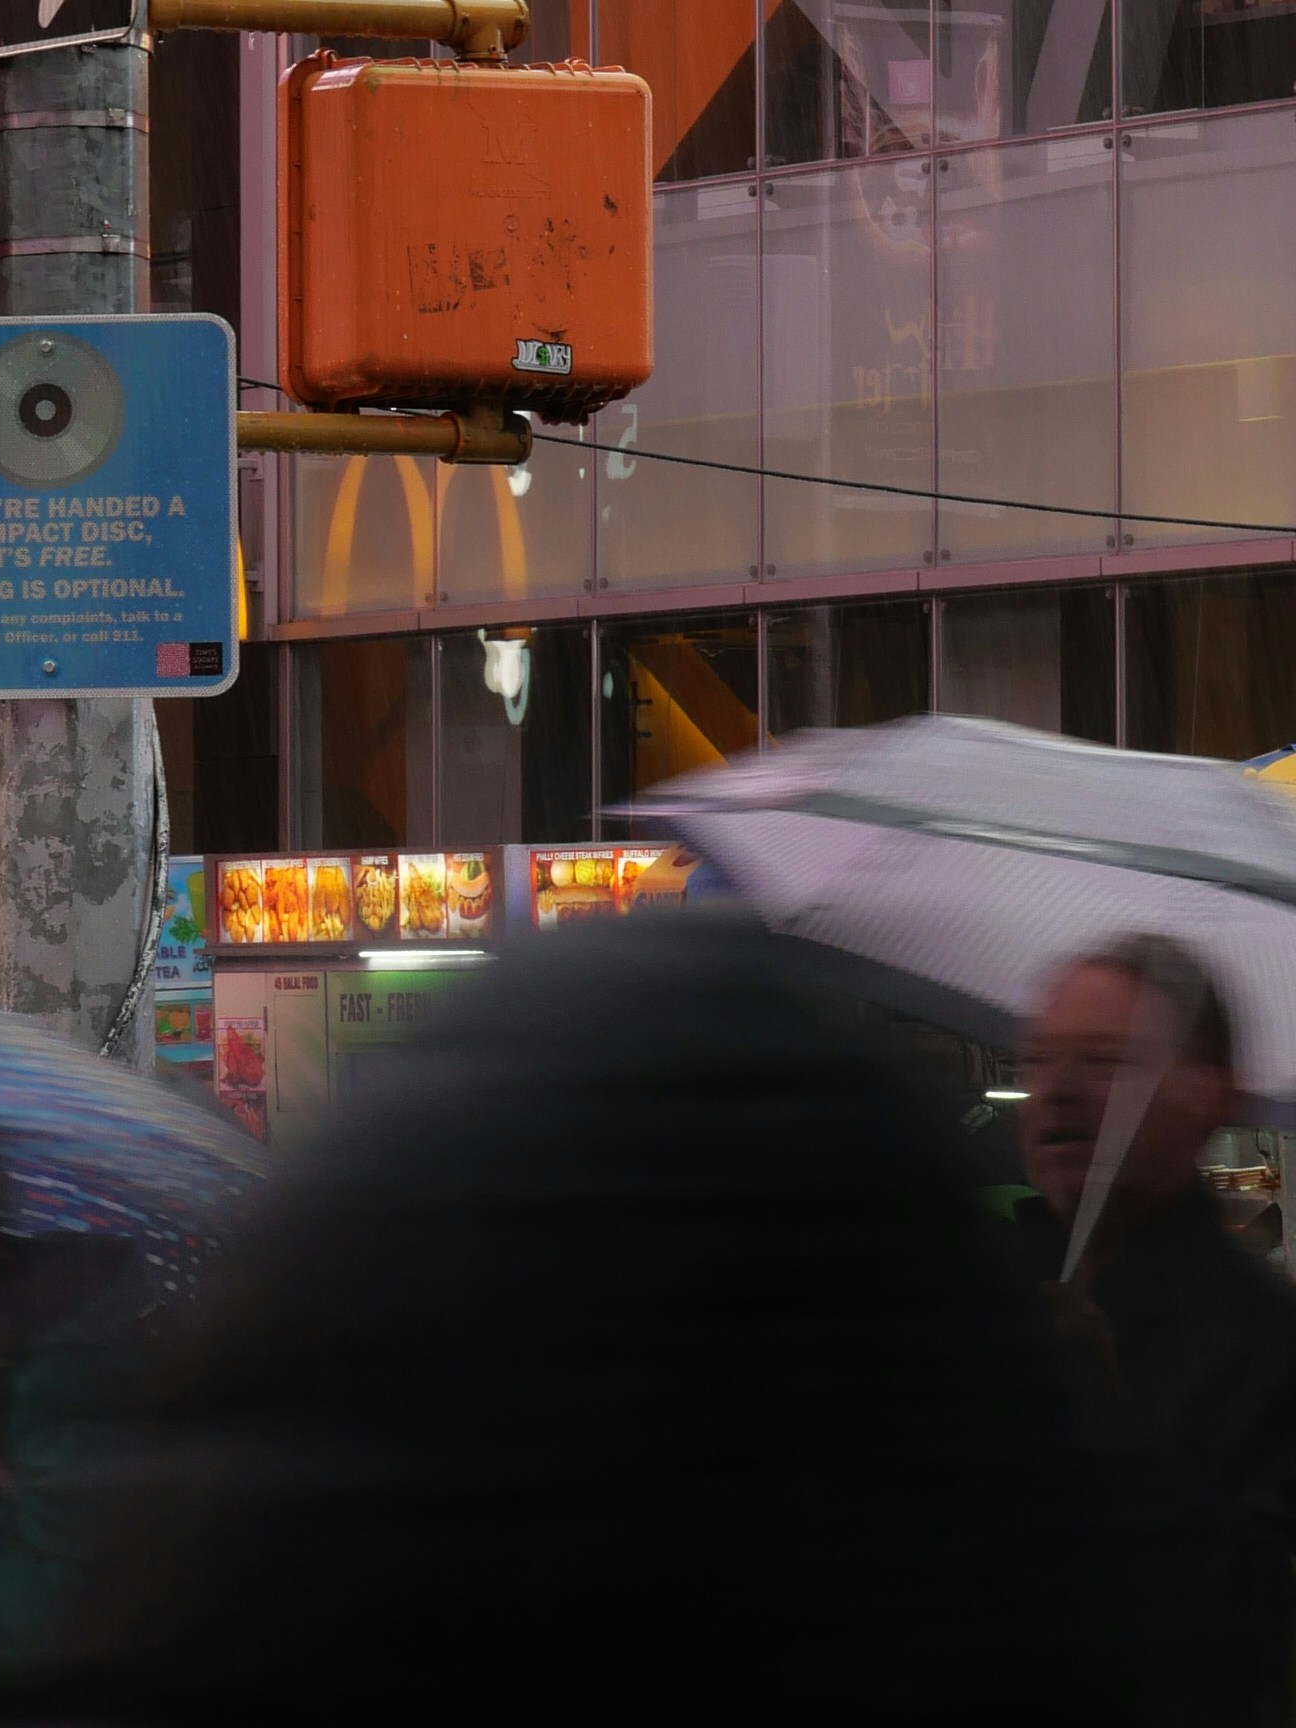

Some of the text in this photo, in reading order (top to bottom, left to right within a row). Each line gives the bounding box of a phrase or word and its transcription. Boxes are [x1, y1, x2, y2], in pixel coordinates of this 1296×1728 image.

[47, 496, 160, 519] HANDED
[167, 495, 186, 516] A
[80, 521, 153, 546] DISC,
[38, 545, 113, 568] FREE.
[21, 579, 47, 600] IS
[53, 577, 186, 599] OPTIONAL.
[1, 614, 27, 628] any
[120, 610, 150, 623] talk
[153, 612, 169, 623] to
[62, 632, 77, 643] or
[81, 630, 109, 643] call
[283, 976, 301, 990] HALAL
[302, 975, 318, 990] FOOD
[339, 993, 372, 1022] FAST
